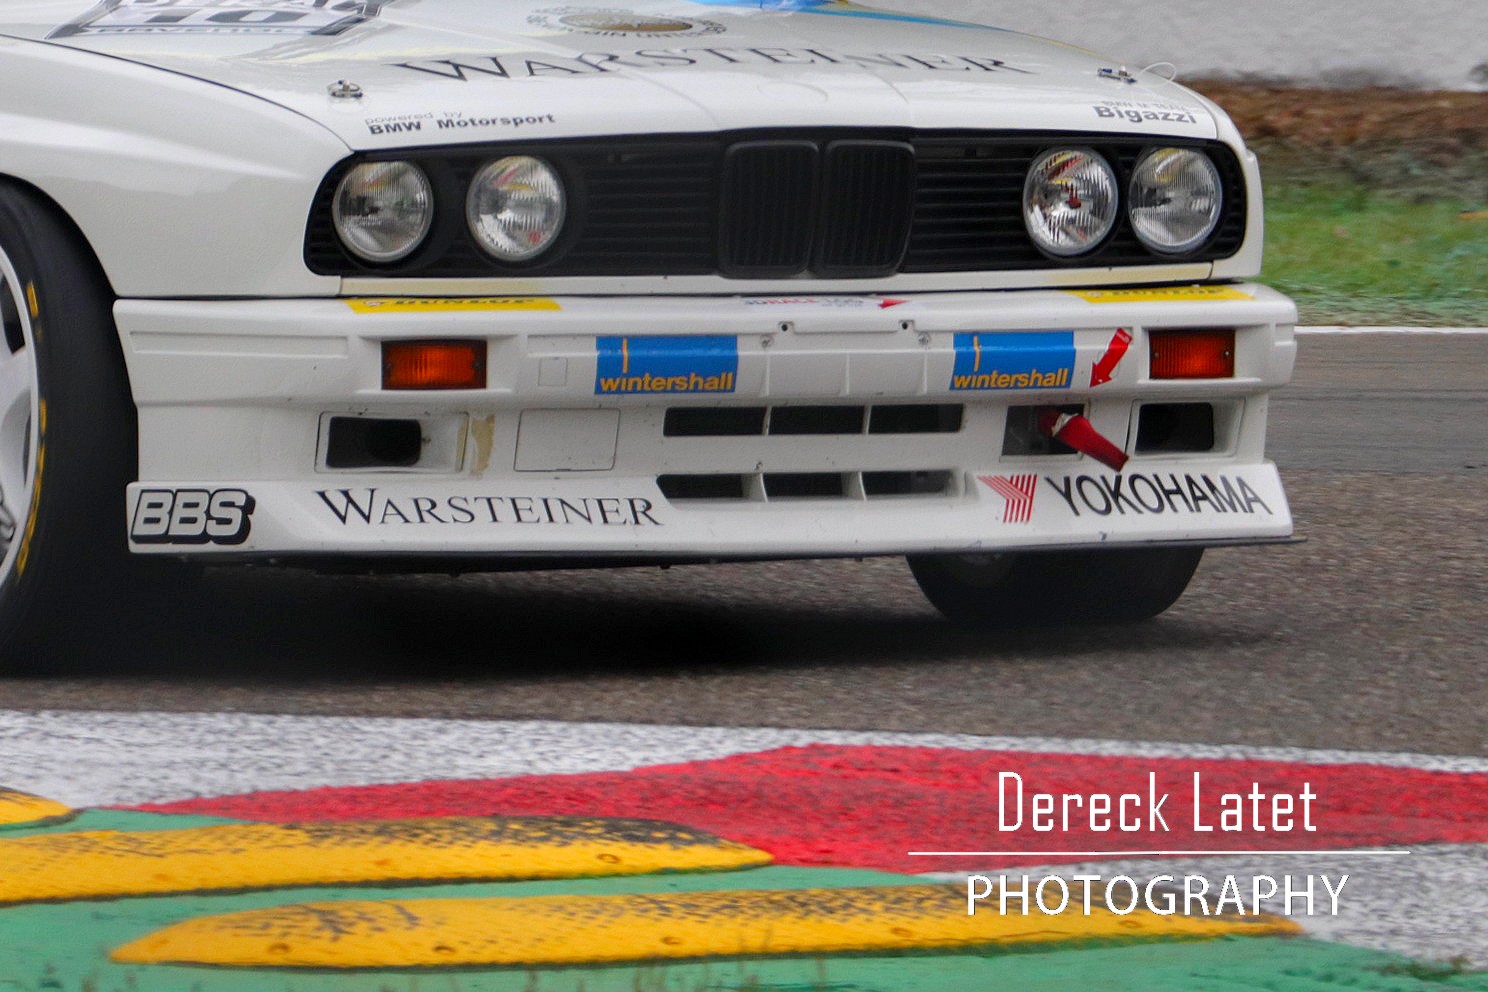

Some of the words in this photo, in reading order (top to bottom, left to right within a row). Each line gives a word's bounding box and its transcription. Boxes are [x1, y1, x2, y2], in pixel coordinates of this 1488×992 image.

[383, 44, 1043, 83] WARSTEINER
[367, 120, 422, 136] BMW
[437, 112, 557, 130] Motorsport
[1093, 105, 1197, 125] Bigazzi
[600, 370, 733, 392] wintershall
[953, 367, 1069, 389] wintershall
[316, 487, 665, 526] WARSTEINER
[1045, 473, 1274, 516] YOKOHAMA
[131, 489, 255, 545] BBS
